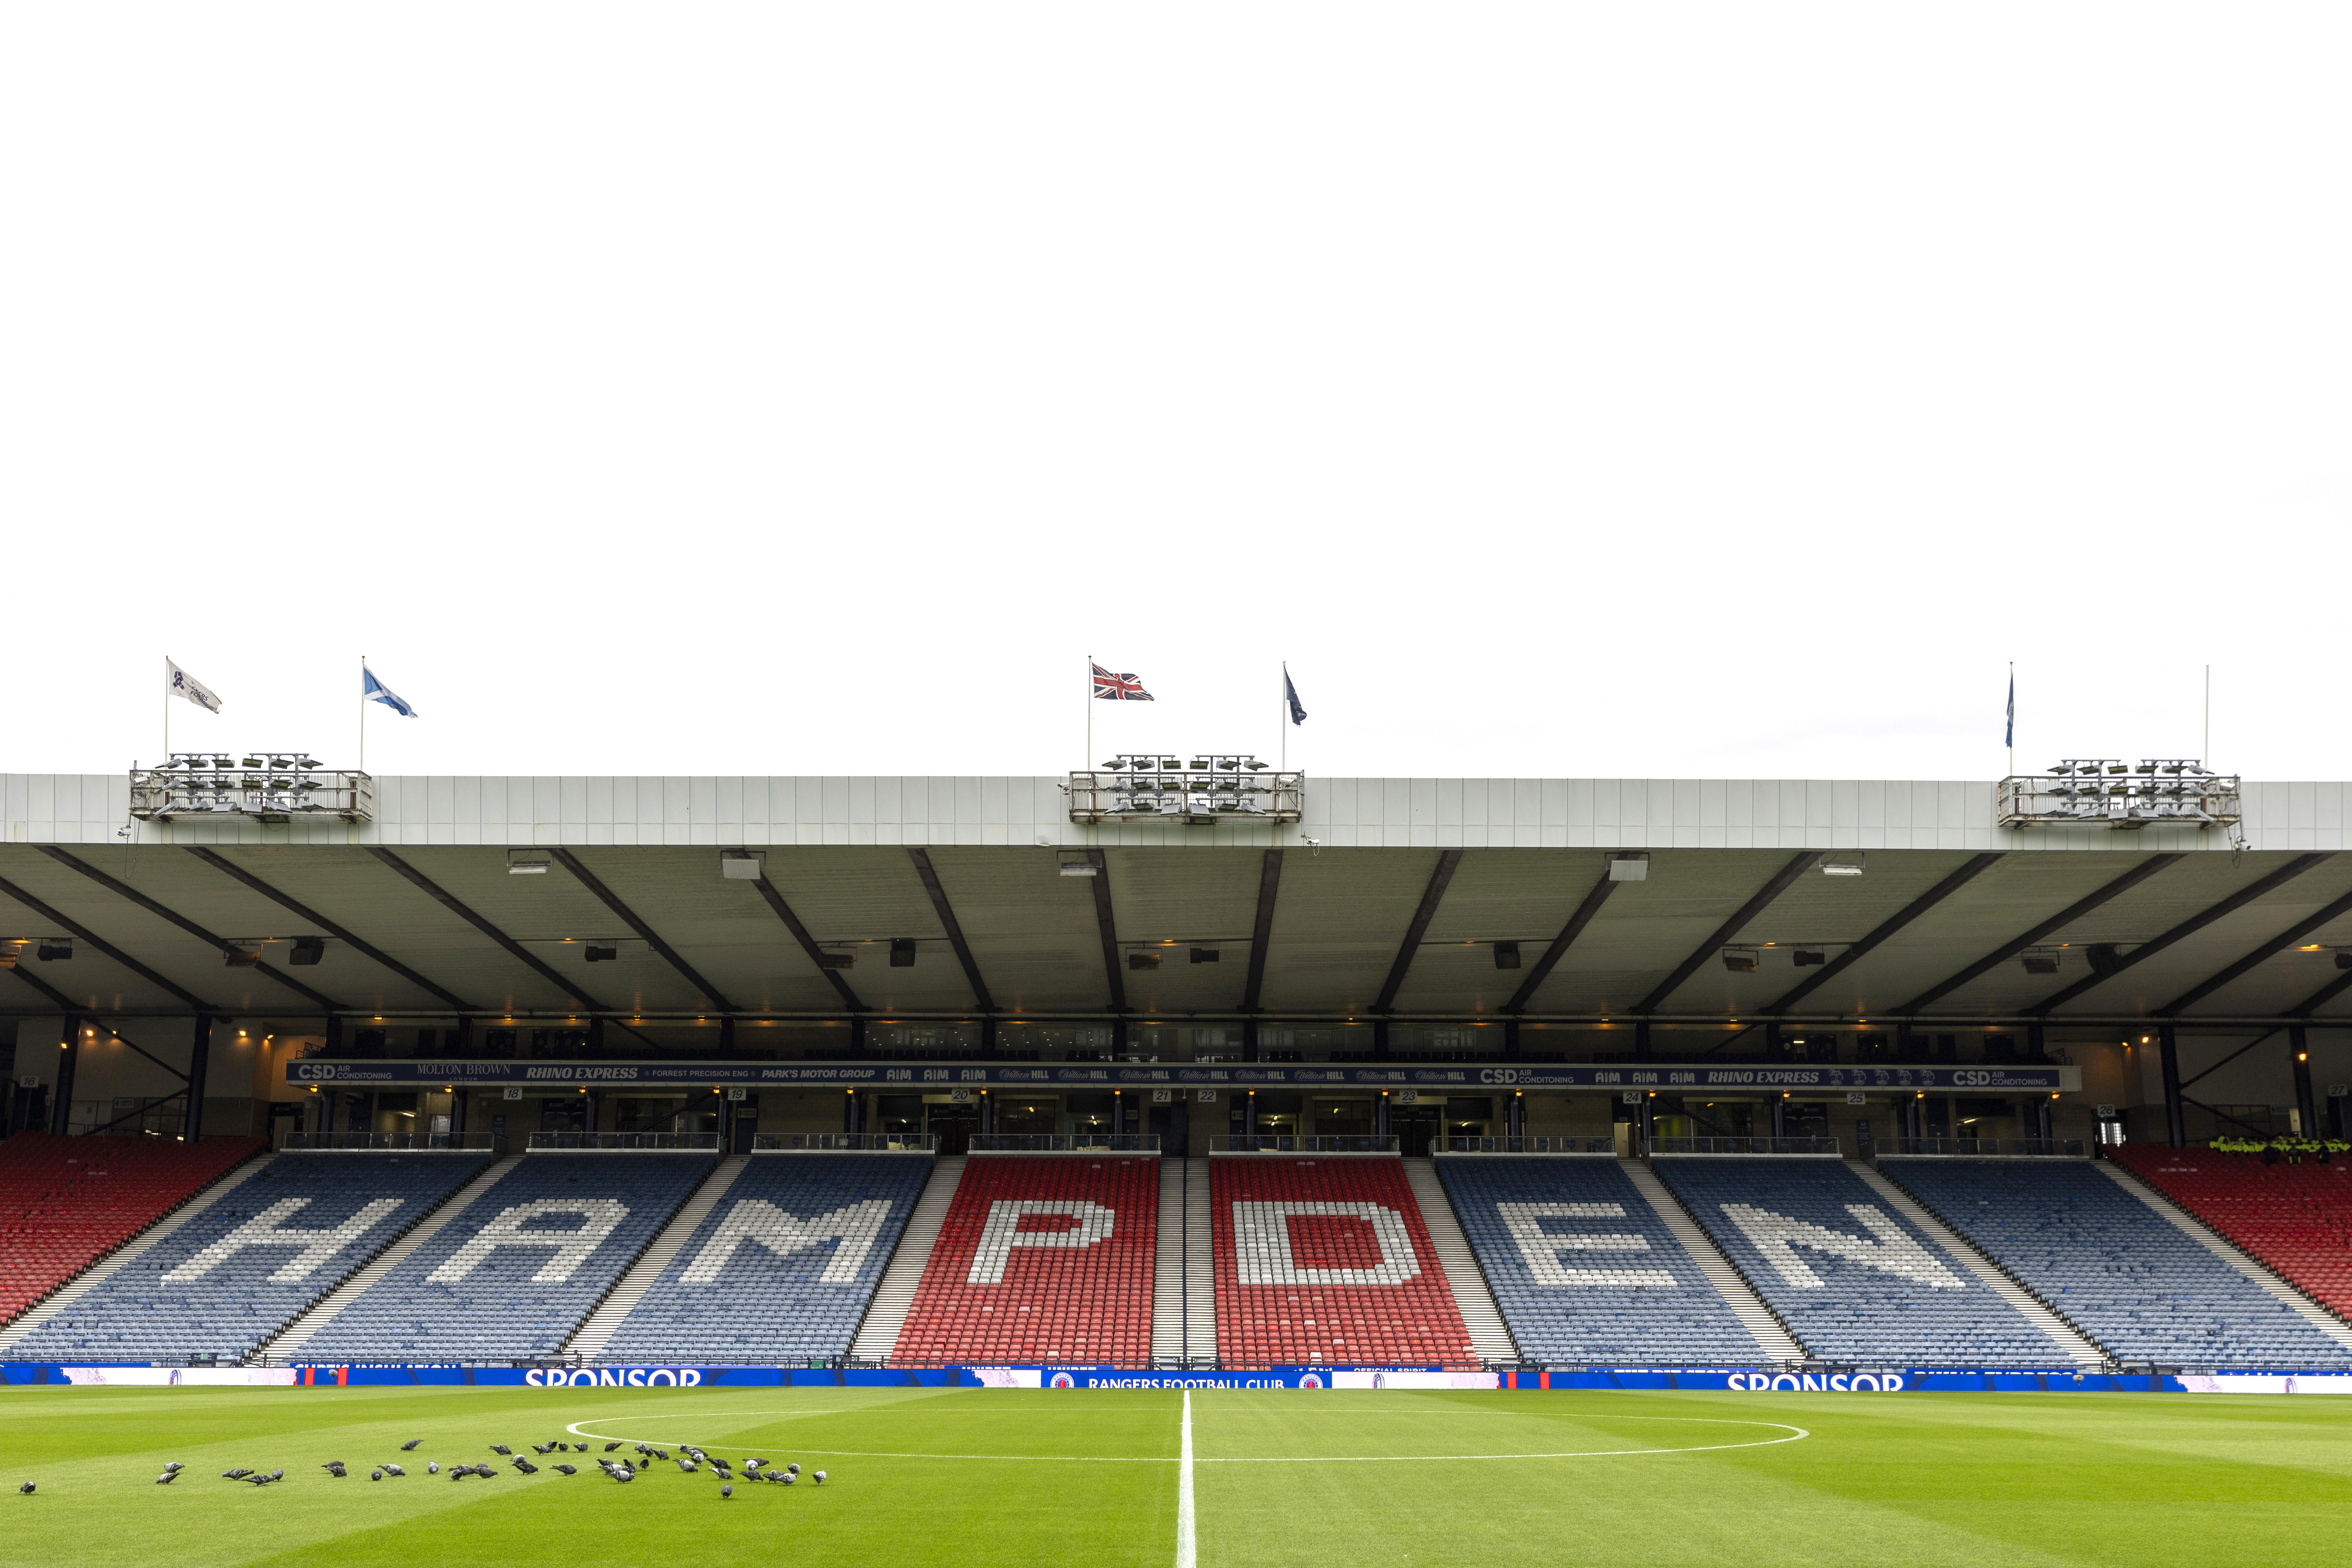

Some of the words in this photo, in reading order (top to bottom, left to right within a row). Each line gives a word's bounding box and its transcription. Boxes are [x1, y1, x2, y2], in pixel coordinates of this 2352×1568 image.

[299, 1065, 336, 1079] CSD
[417, 1064, 461, 1074] MOLTON
[466, 1064, 510, 1074] BROWN
[526, 1067, 572, 1078] RHINO
[575, 1067, 638, 1078] EXPRESS
[762, 1070, 798, 1078] PARK'S
[840, 1070, 875, 1078] GROUP
[999, 1069, 1031, 1079] William
[1058, 1069, 1090, 1079] William
[887, 1070, 911, 1080] AIM
[924, 1070, 949, 1080] AIM
[961, 1070, 986, 1080] AIM
[1120, 1069, 1152, 1080] William
[1179, 1070, 1211, 1080] William
[1211, 1071, 1229, 1079] HILL
[1235, 1070, 1267, 1080] William
[1294, 1070, 1327, 1080] William
[1327, 1071, 1344, 1080] HILL
[1356, 1071, 1388, 1080] William
[1415, 1071, 1448, 1080] William
[1448, 1072, 1465, 1080] HILL
[1480, 1069, 1517, 1083] CSD
[1595, 1073, 1620, 1082] AIM
[1633, 1073, 1657, 1082] AIM
[1670, 1073, 1695, 1083] AIM
[1708, 1072, 1753, 1082] RHINO
[1757, 1072, 1819, 1083] EXPRESS
[1953, 1071, 1990, 1085] CSD
[24, 1077, 36, 1085] 16
[507, 1089, 519, 1098] 18
[731, 1090, 742, 1098] 19
[953, 1091, 968, 1099] 20
[2332, 1086, 2345, 1094] 27
[1156, 1091, 1168, 1100] 21
[1200, 1092, 1214, 1100] 22
[1402, 1092, 1416, 1101] 23
[1626, 1093, 1639, 1102] 24
[1849, 1094, 1863, 1103] 25
[2100, 1106, 2112, 1114] 26
[526, 1369, 701, 1387] SPONSOR
[1728, 1374, 1903, 1391] SPONSOR
